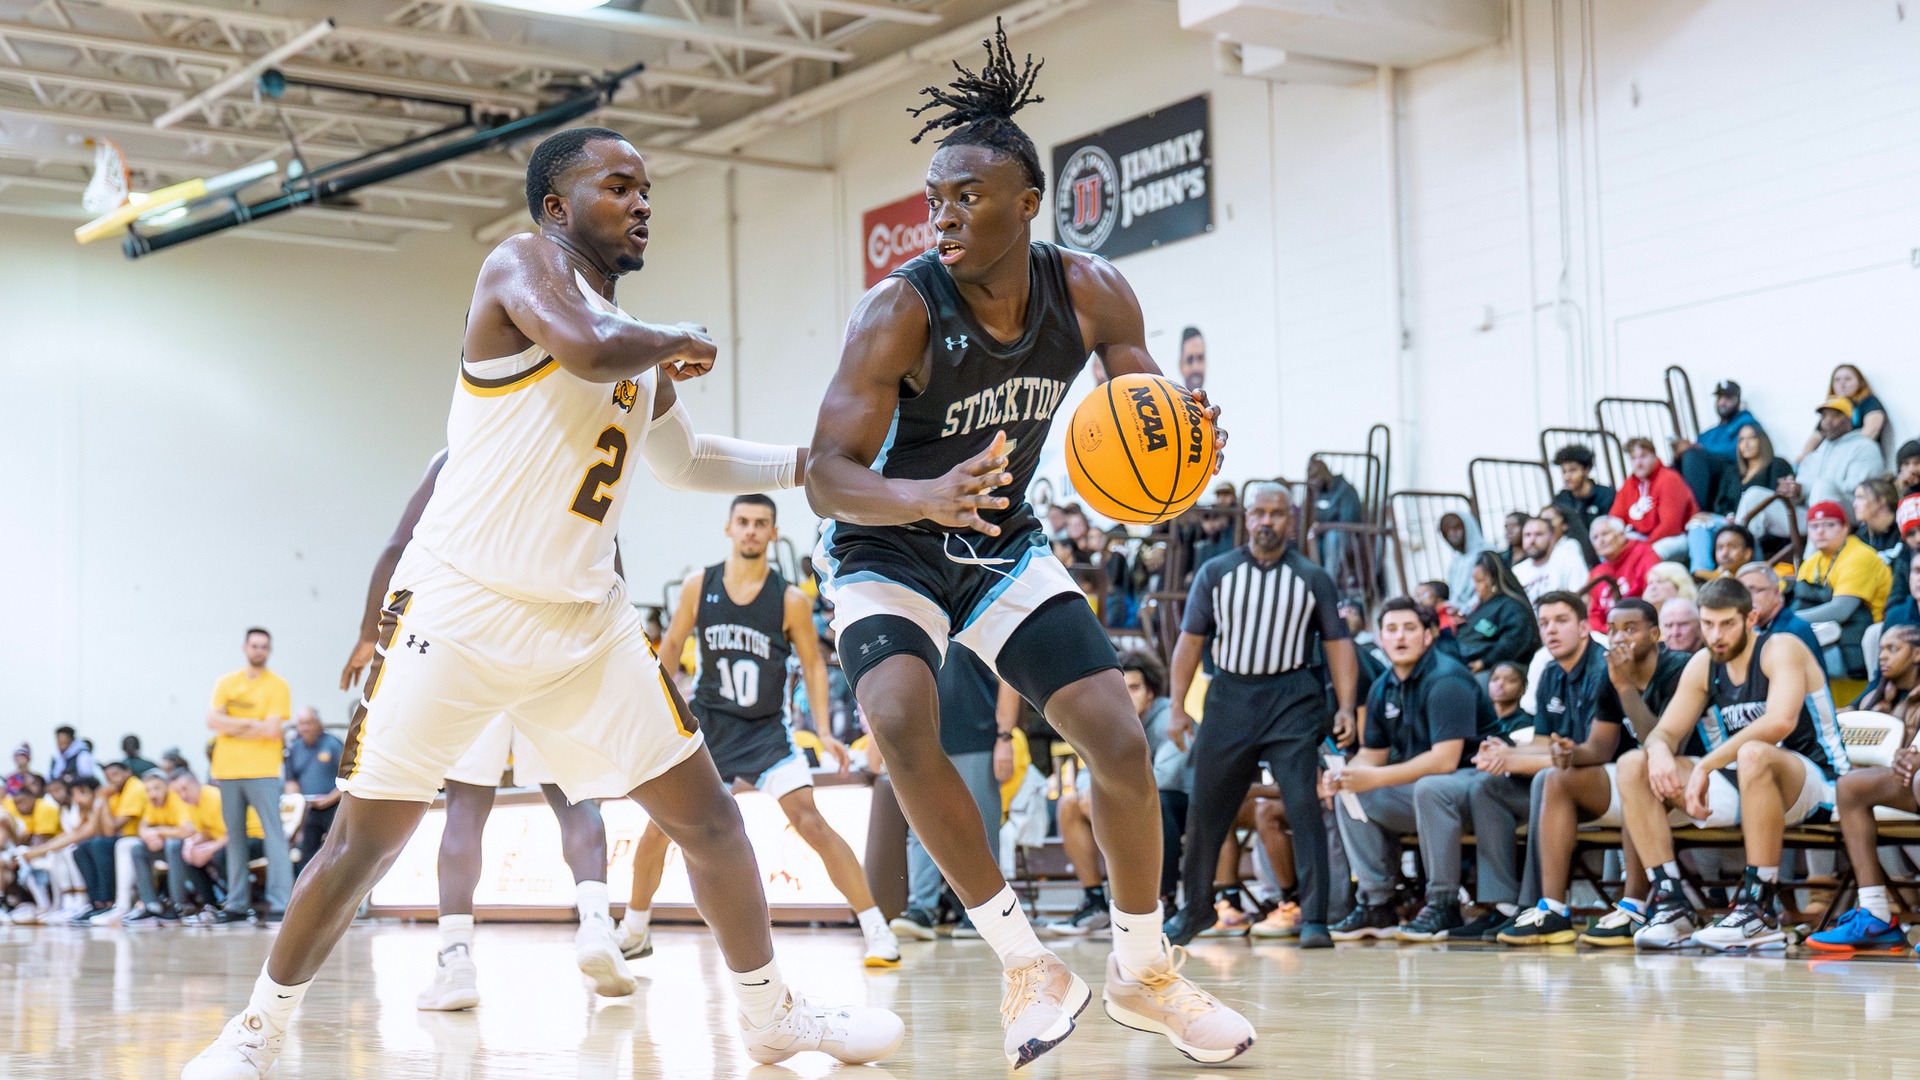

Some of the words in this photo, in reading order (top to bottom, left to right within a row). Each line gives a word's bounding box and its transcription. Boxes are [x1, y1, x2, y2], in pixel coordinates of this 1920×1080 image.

[1120, 129, 1204, 190] JIMMY
[1120, 166, 1206, 228] JOHN'S
[941, 377, 1066, 437] STOCKTON
[1128, 386, 1168, 452] NCAA
[1137, 433, 1145, 453] BALL
[568, 423, 628, 526] 2
[705, 624, 771, 660] STOCKTON
[716, 657, 760, 707] 10
